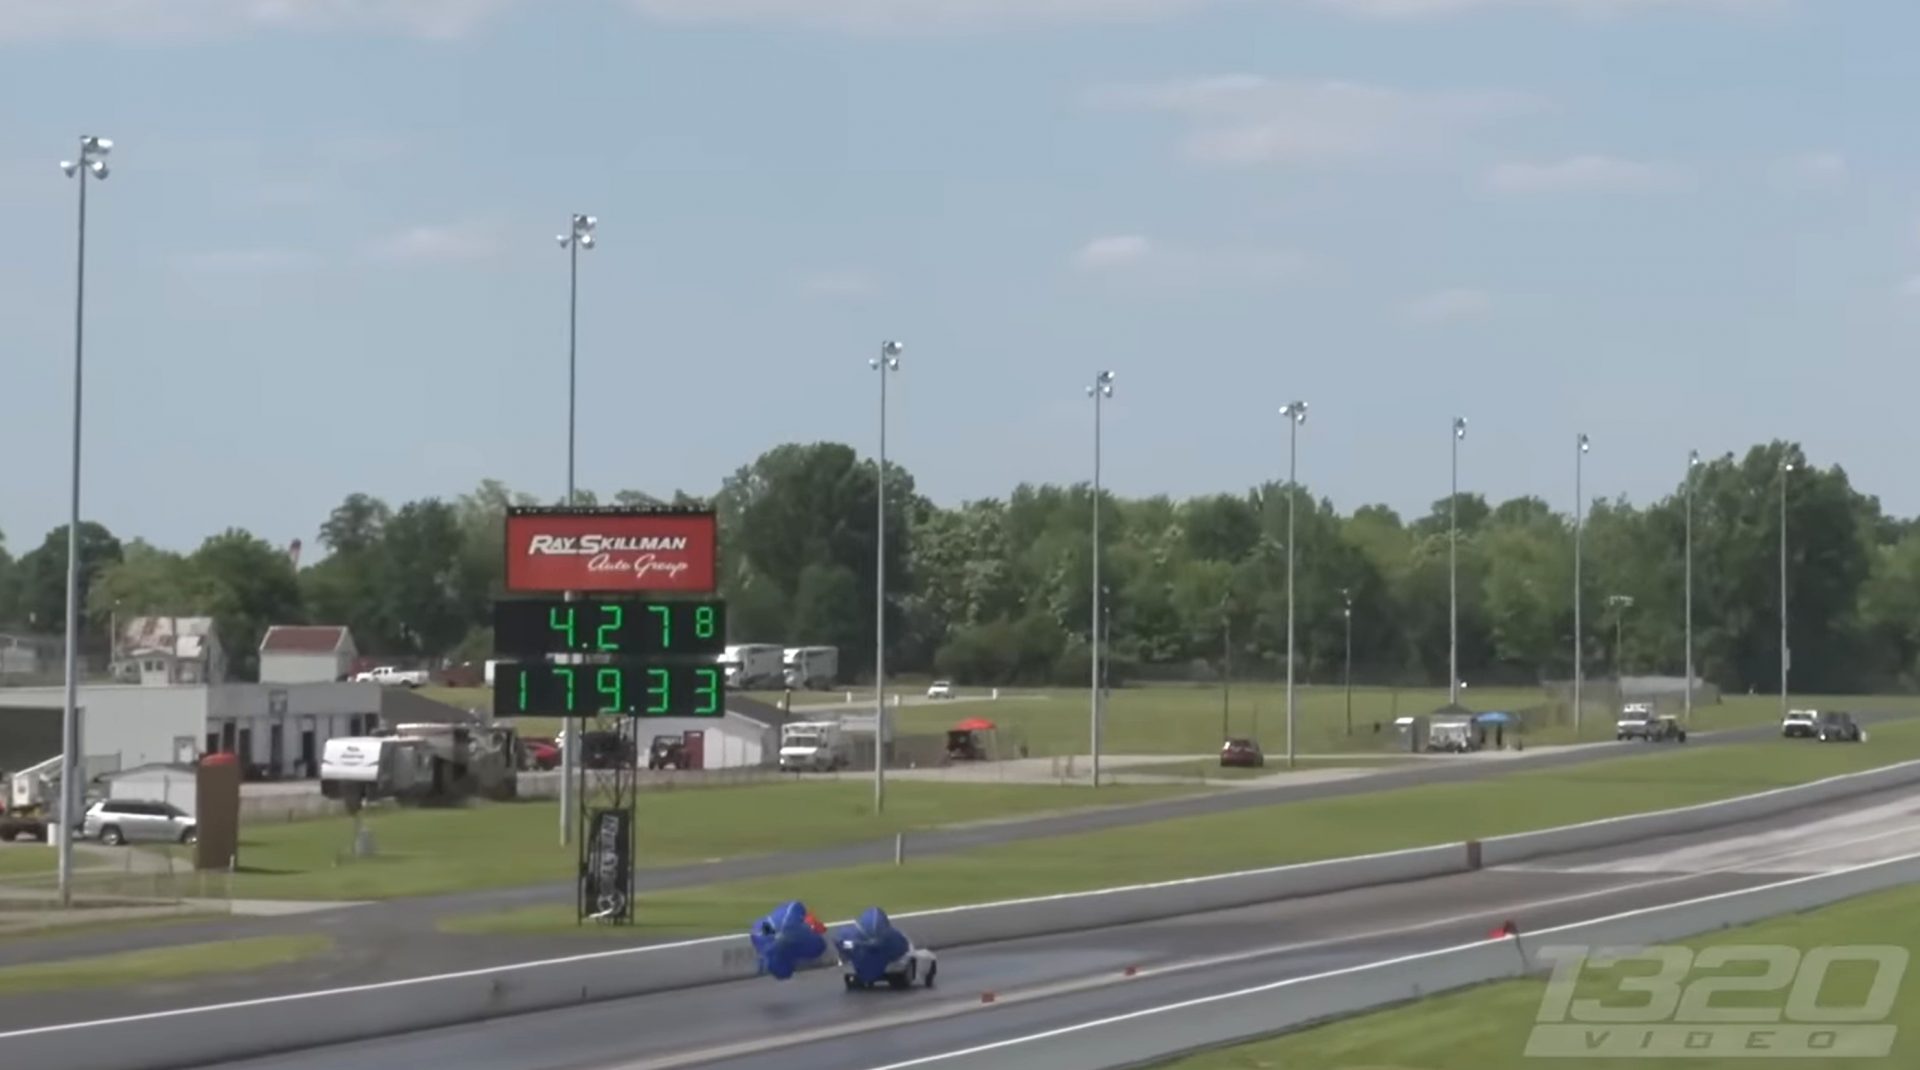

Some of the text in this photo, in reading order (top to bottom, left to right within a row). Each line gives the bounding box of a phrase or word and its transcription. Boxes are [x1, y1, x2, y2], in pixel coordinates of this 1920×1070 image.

[528, 534, 687, 555] RAY SKILLMAN
[587, 553, 688, 578] Auto Group
